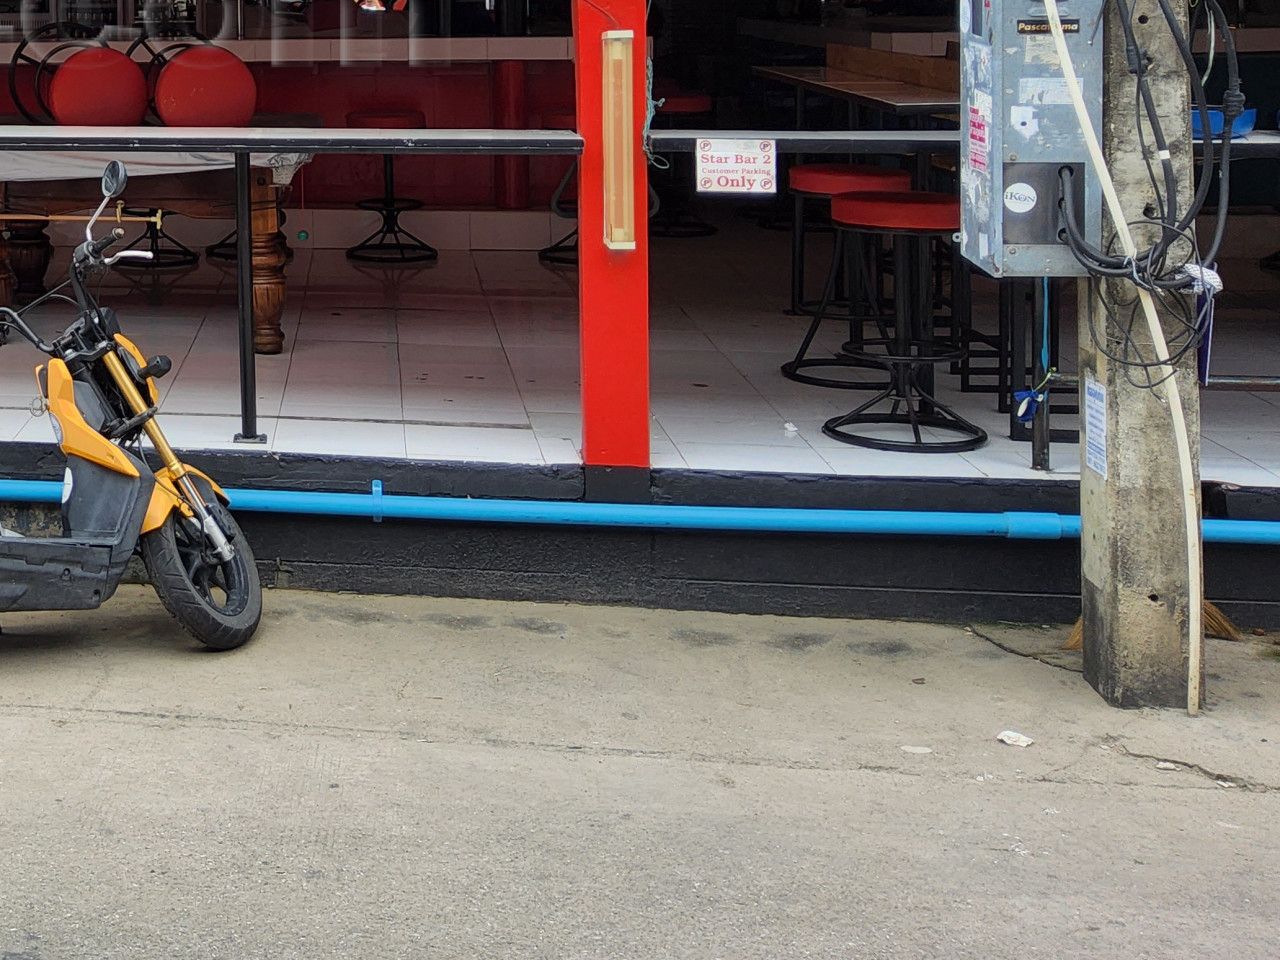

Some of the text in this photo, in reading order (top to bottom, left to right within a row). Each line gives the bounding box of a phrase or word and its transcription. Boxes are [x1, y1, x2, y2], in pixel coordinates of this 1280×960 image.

[701, 153, 771, 164] Star Bar 2
[741, 168, 771, 176] Parking
[716, 175, 756, 190] Only
